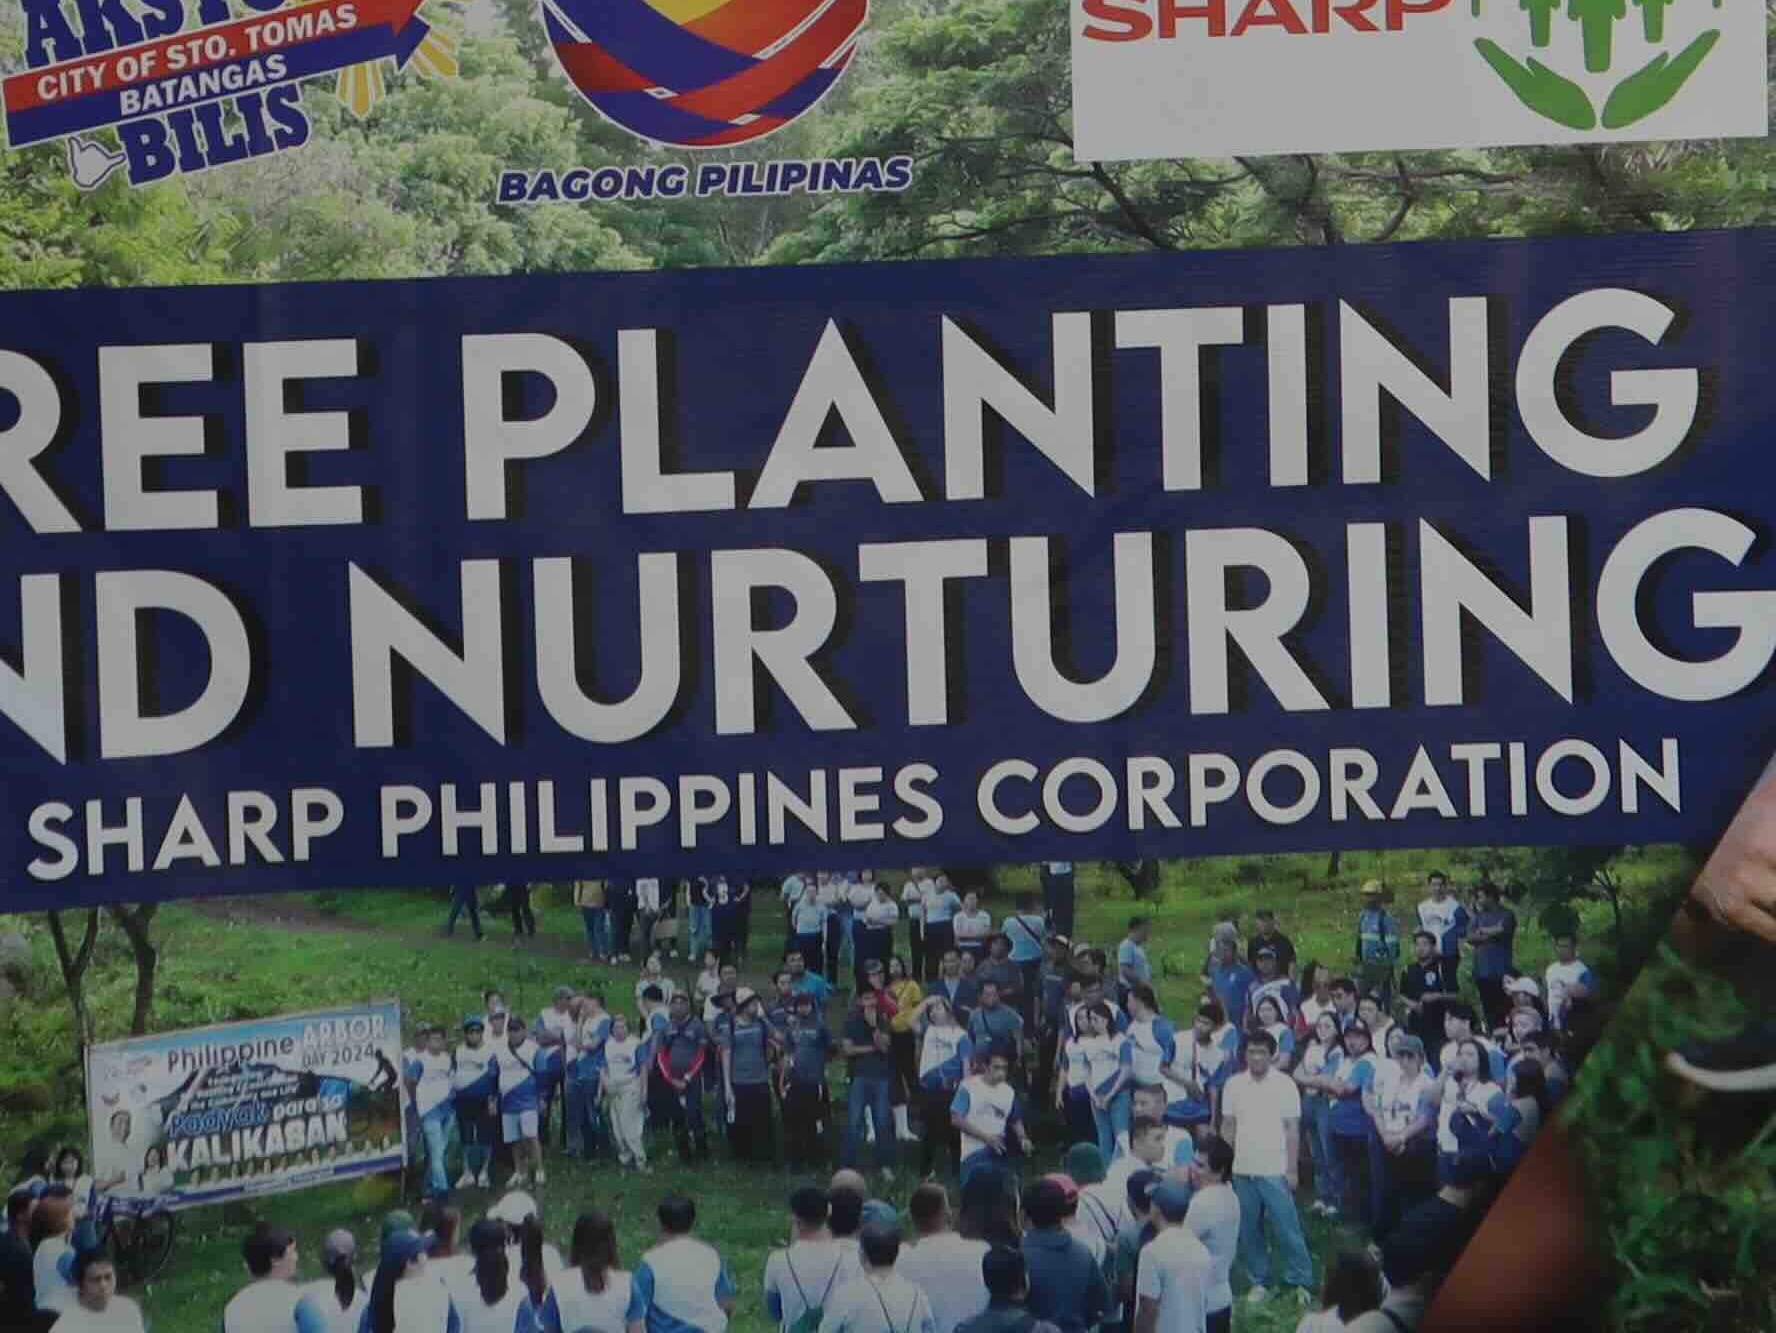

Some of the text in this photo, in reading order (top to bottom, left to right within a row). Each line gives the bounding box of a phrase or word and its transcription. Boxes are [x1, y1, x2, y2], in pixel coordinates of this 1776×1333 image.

[37, 3, 358, 101] CITY OF STO. TOMAS
[119, 53, 287, 117] BATANGAS
[117, 83, 309, 187] BILIS
[498, 156, 912, 202] BAGONG PILIPINAS
[461, 287, 1699, 520] PLANTING
[27, 788, 344, 881] SHARP
[380, 761, 943, 858] PHILIPPINES
[976, 738, 1683, 834] CORPORATION
[168, 1036, 294, 1073] Philippine
[331, 1043, 374, 1064] 2024
[168, 1110, 349, 1173] KALIKASAN
